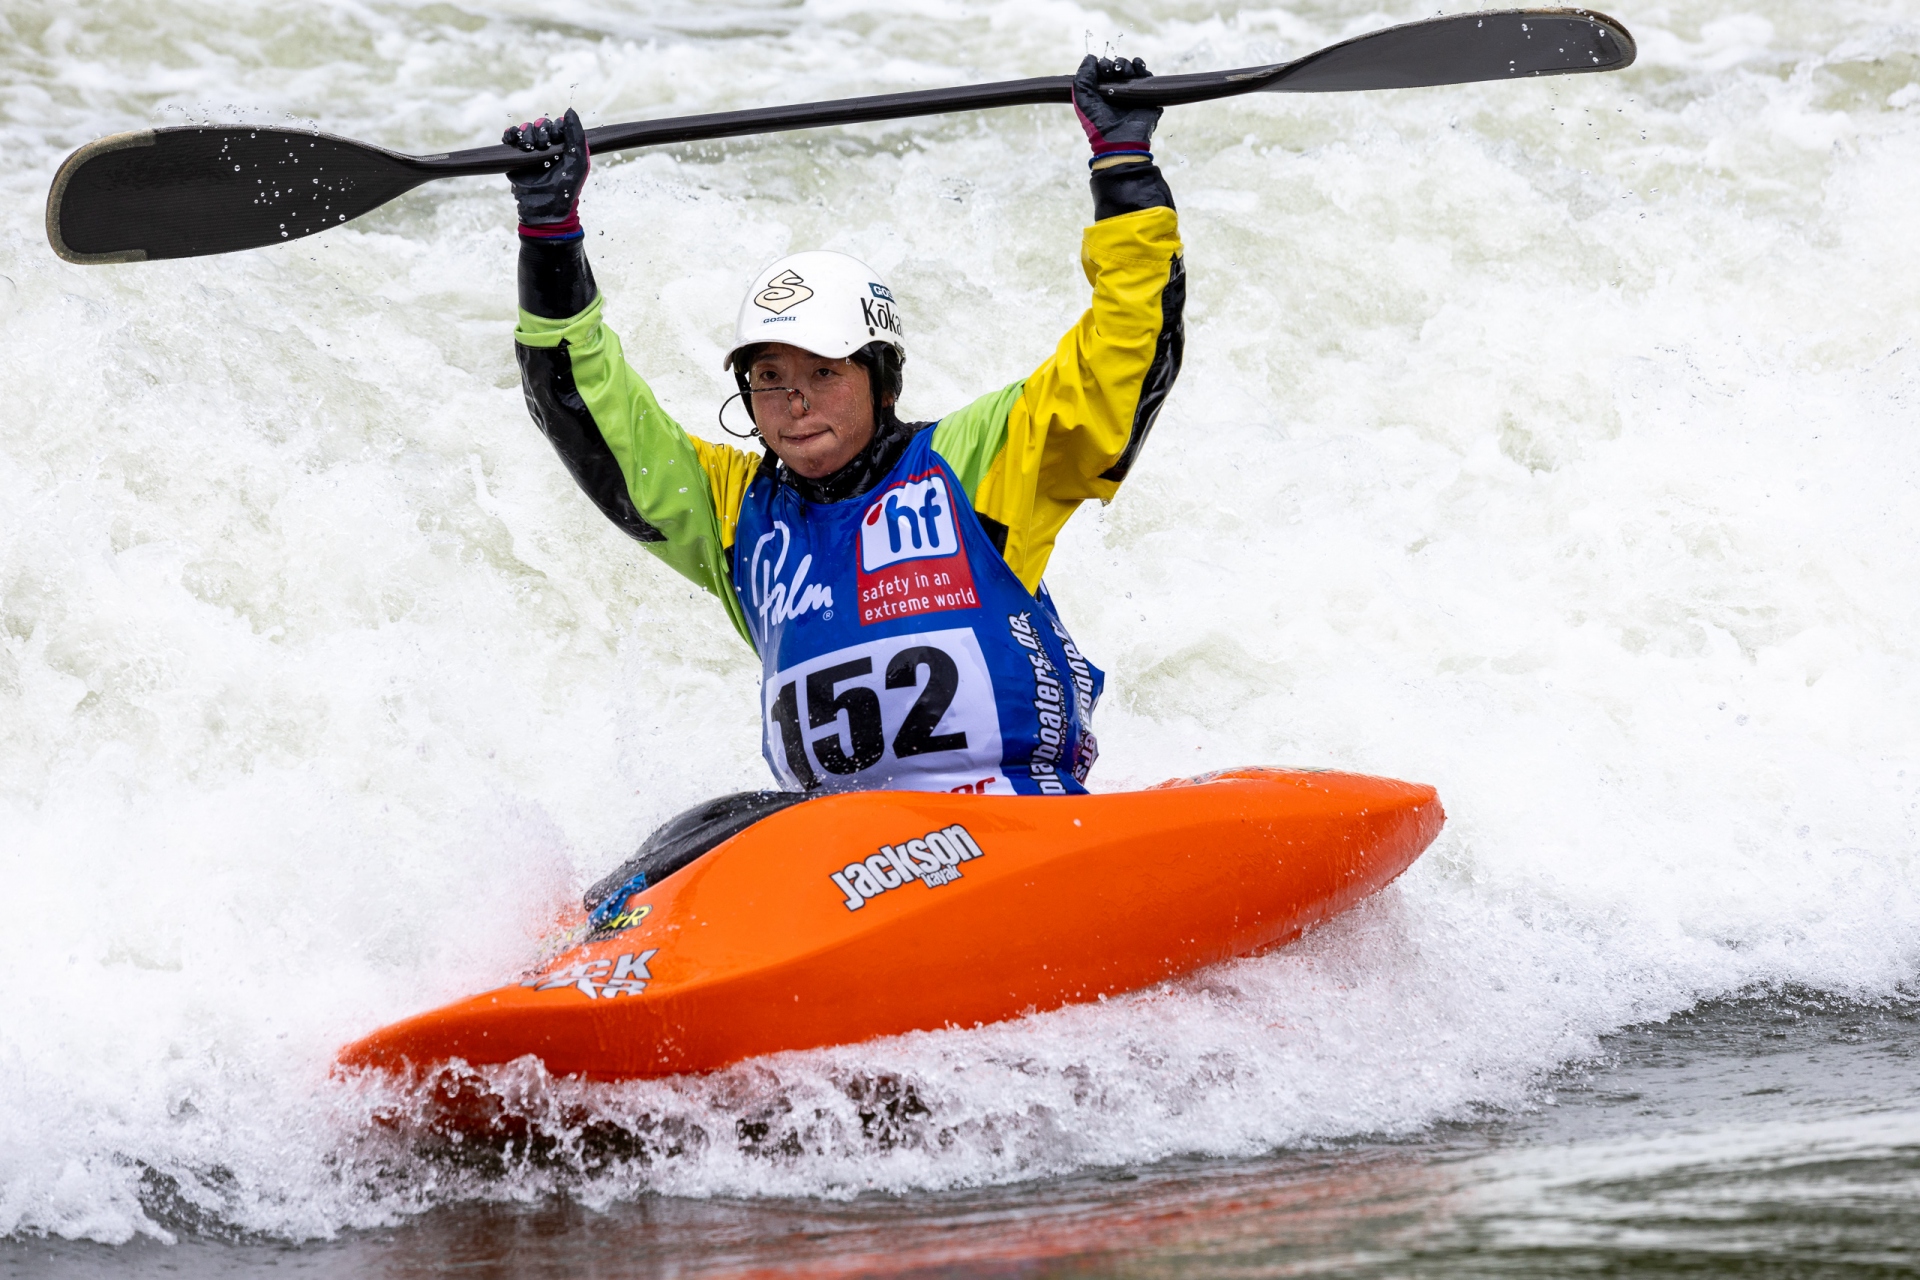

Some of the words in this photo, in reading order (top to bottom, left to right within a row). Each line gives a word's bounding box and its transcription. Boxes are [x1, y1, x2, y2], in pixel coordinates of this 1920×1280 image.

[763, 316, 797, 324] GOSHI
[860, 297, 904, 339] Kōka
[751, 520, 834, 643] Palm
[862, 575, 909, 602] safety
[914, 572, 930, 588] in
[933, 572, 950, 586] an
[865, 596, 930, 620] extreme
[934, 587, 976, 607] world
[770, 646, 969, 791] 152
[829, 823, 985, 912] jackson
[919, 863, 964, 889] kayak
